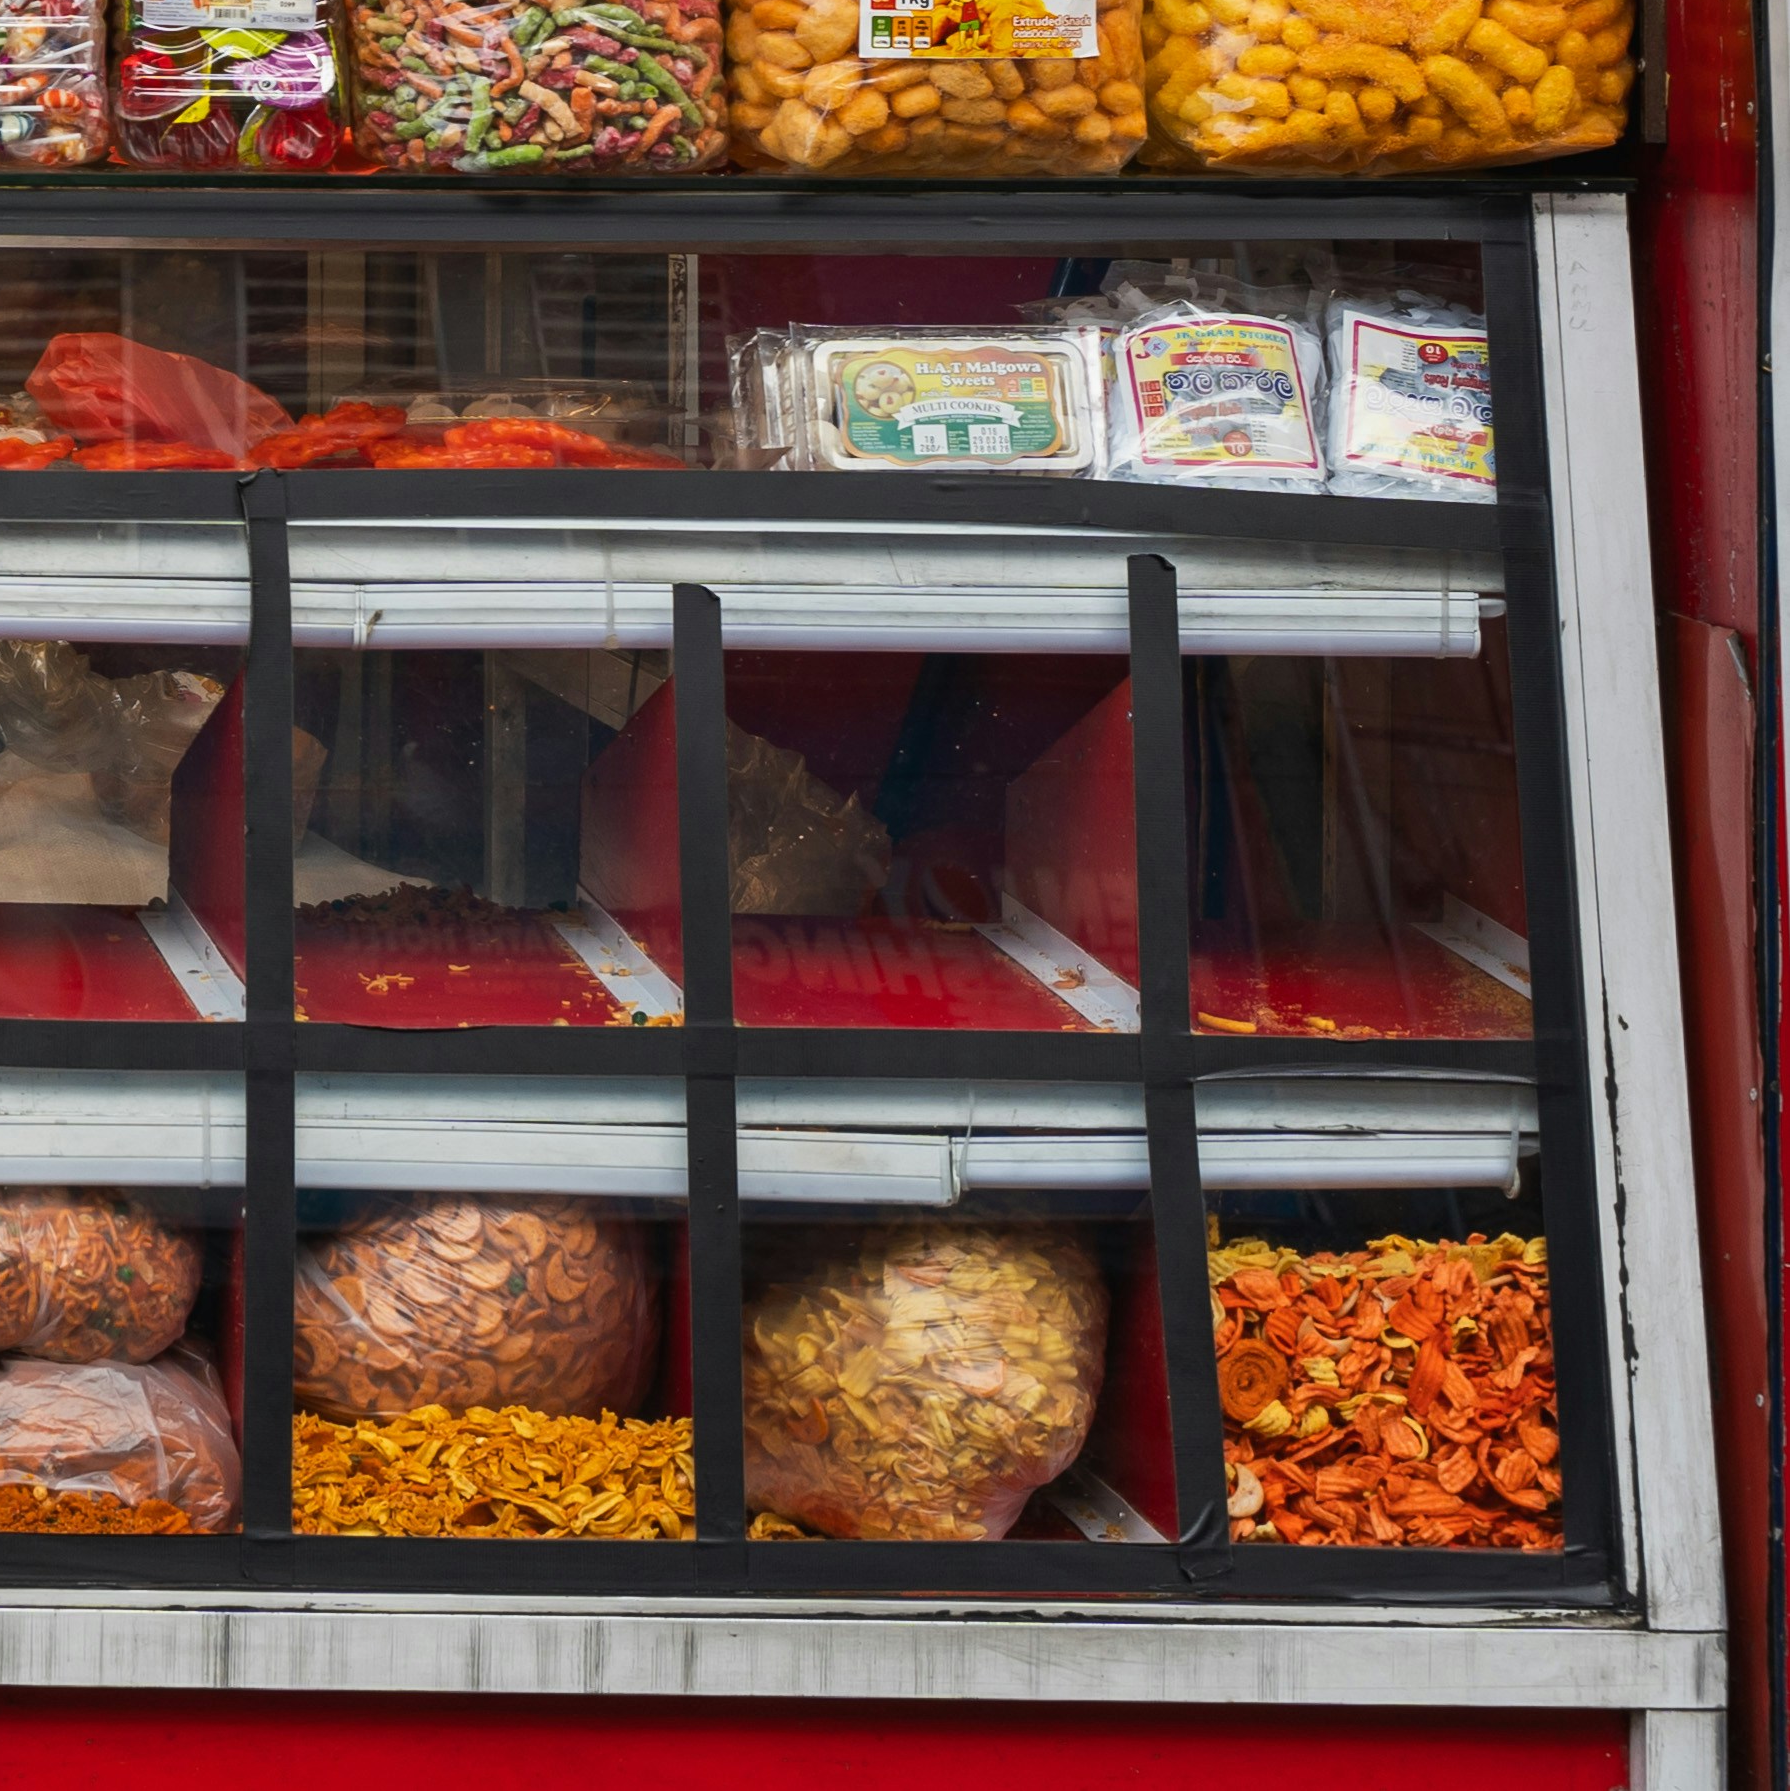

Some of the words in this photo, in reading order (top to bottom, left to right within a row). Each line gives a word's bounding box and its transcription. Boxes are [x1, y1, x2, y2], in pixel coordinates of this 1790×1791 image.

[1013, 16, 1060, 27] Extruded
[1239, 330, 1288, 346] STORES
[1425, 345, 1442, 355] 10
[915, 362, 961, 374] H.A.T
[966, 361, 1042, 376] Malgowa
[941, 375, 996, 387] Sweets
[912, 400, 948, 414] MULTI
[950, 398, 1001, 414] COOKIES
